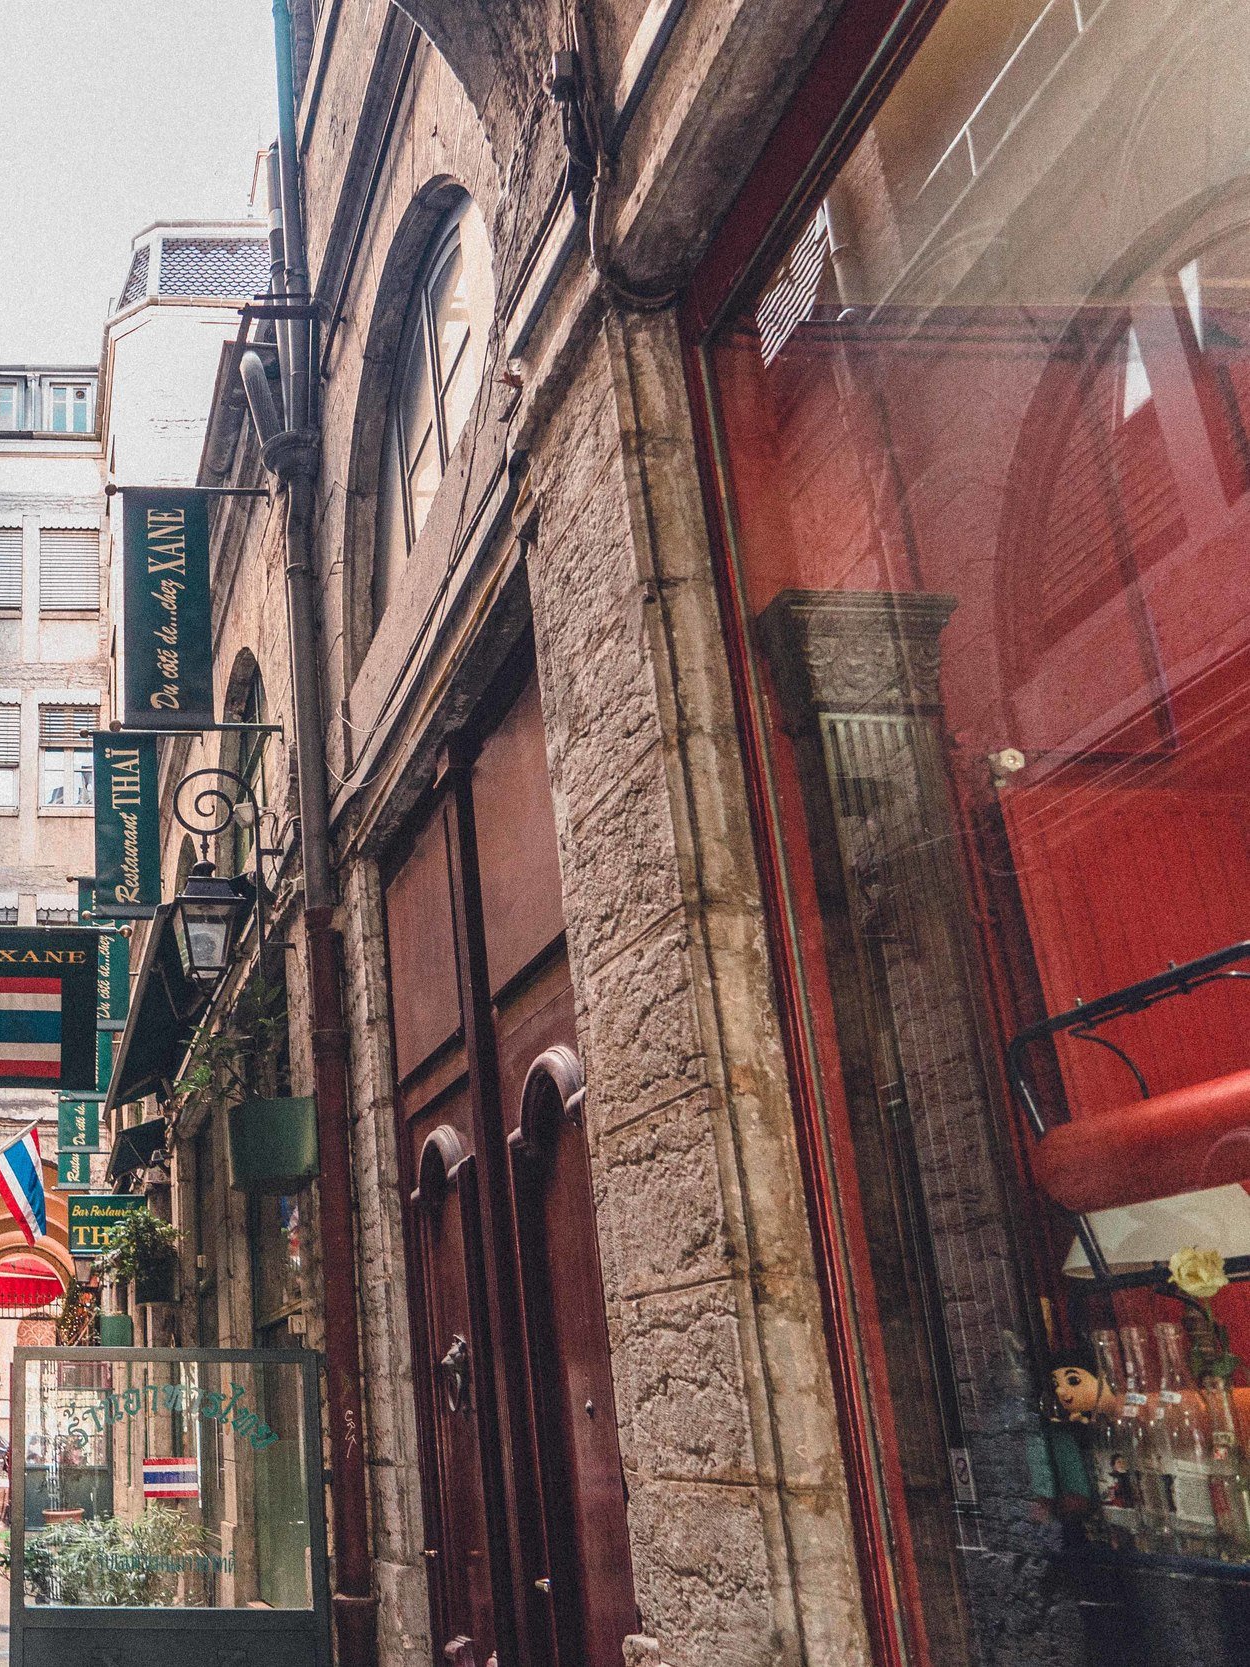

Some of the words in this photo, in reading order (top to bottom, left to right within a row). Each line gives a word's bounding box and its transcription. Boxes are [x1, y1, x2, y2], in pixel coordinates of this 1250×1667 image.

[147, 507, 186, 576] XANE
[156, 649, 179, 678] côté
[150, 684, 179, 710] Du
[105, 748, 141, 810] THAÏ
[114, 812, 141, 904] Restaurant
[71, 1204, 89, 1217] Bar
[63, 1381, 280, 1450] ร้านอาหารไทย
